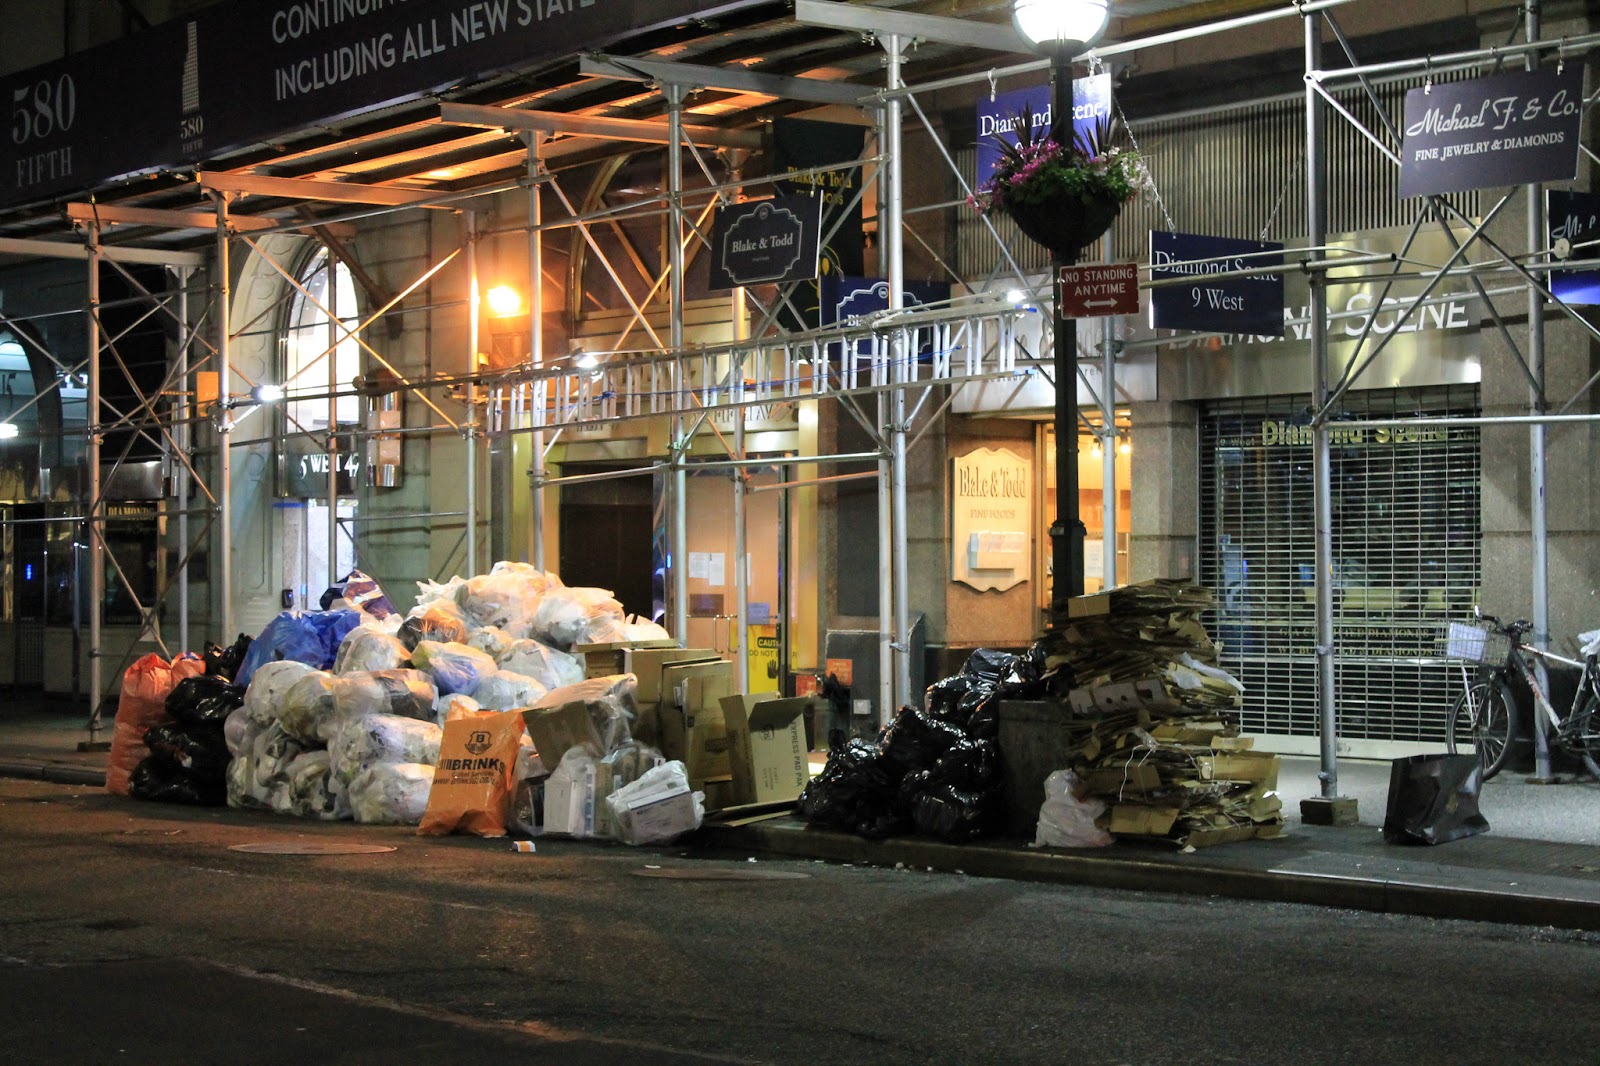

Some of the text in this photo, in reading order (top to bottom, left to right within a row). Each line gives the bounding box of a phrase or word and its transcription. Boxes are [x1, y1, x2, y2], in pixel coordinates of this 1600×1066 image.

[275, 33, 396, 100] INCLUDING
[402, 19, 446, 63] ALL
[451, 0, 508, 47] NEW
[12, 73, 76, 144] 580
[1406, 99, 1490, 136] Michael
[1522, 97, 1542, 121] &
[1548, 89, 1580, 117] Co.
[180, 114, 204, 139] 580
[1414, 131, 1565, 161] FINE JEWELRY & DIAMONDS
[16, 146, 73, 188] FIFTH
[732, 232, 793, 253] Blake & Todd
[1065, 268, 1134, 283] NO STANDING
[1074, 283, 1126, 297] ANYTIME
[1191, 286, 1244, 311] 9 West
[310, 453, 343, 473] WET
[959, 466, 1026, 498] Blake & Todd
[970, 509, 1016, 519] FINE FOODS
